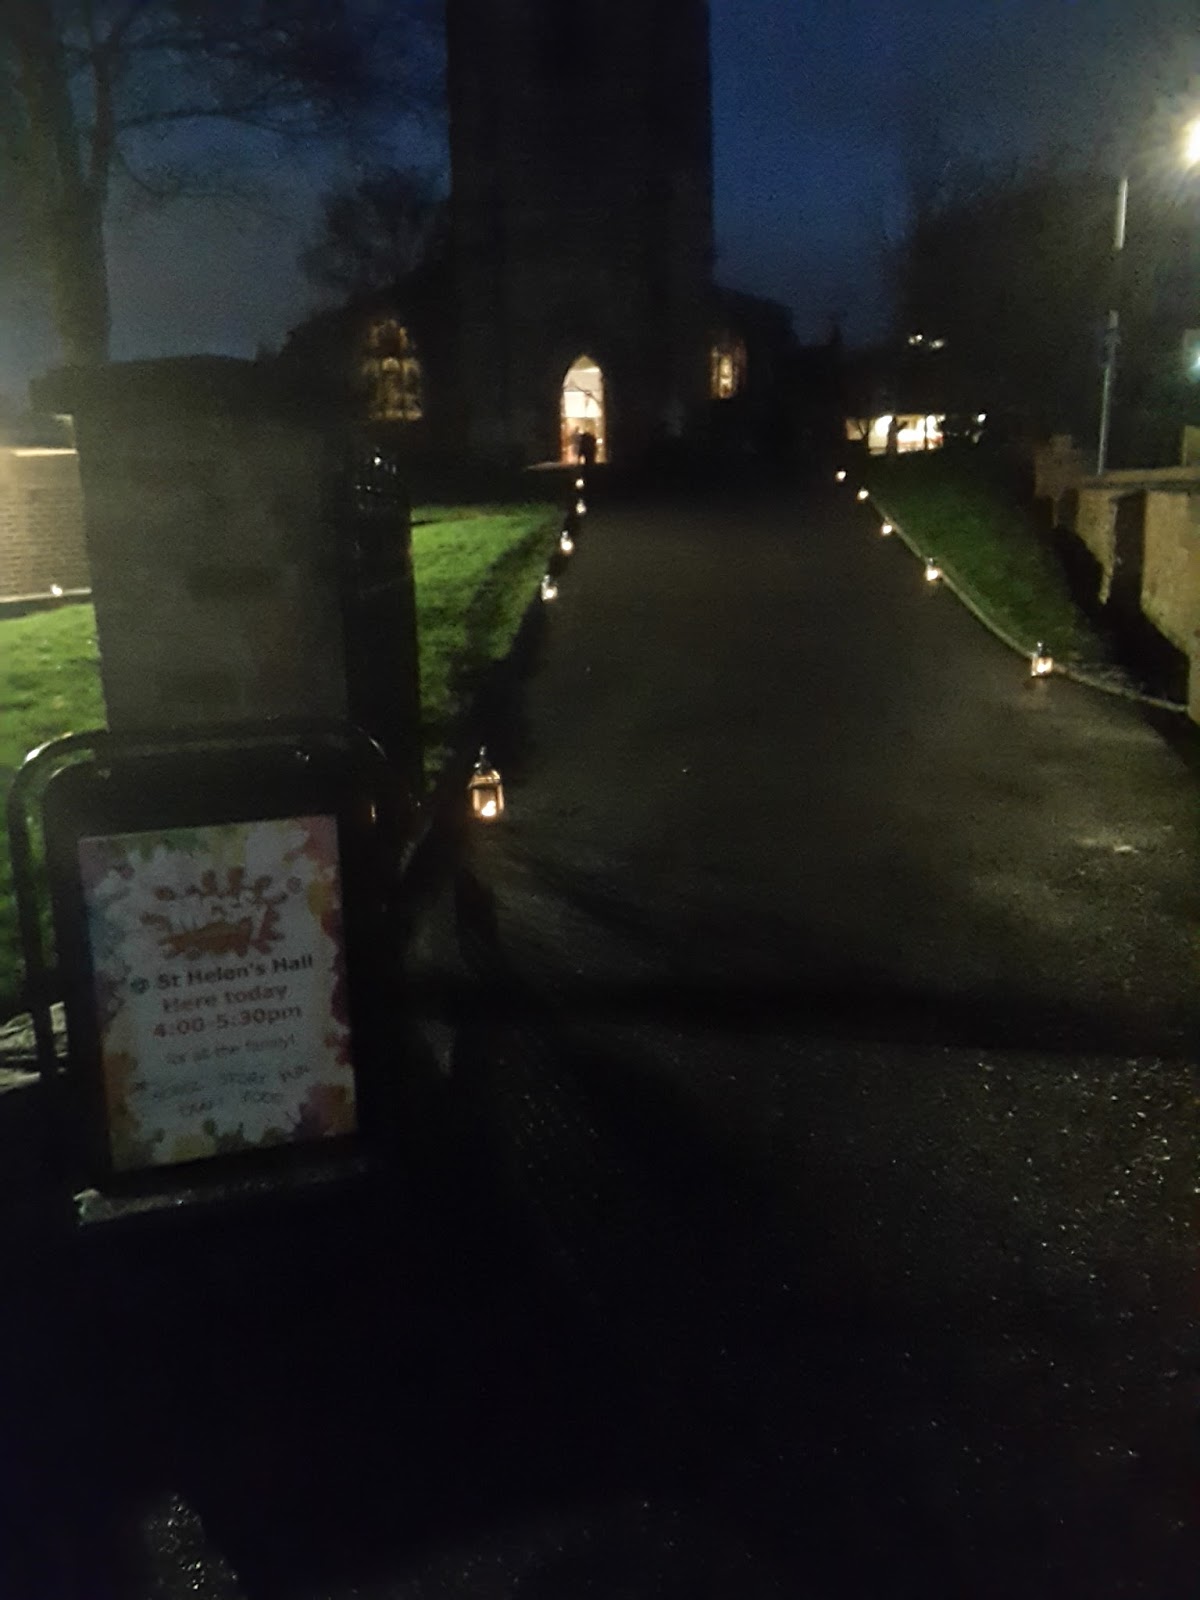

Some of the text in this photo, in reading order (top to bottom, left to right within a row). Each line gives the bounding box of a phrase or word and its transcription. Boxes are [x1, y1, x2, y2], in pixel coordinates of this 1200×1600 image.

[157, 973, 181, 990] St
[187, 963, 267, 985] Helen's
[271, 954, 313, 973] Hall
[162, 985, 288, 1013] Here today
